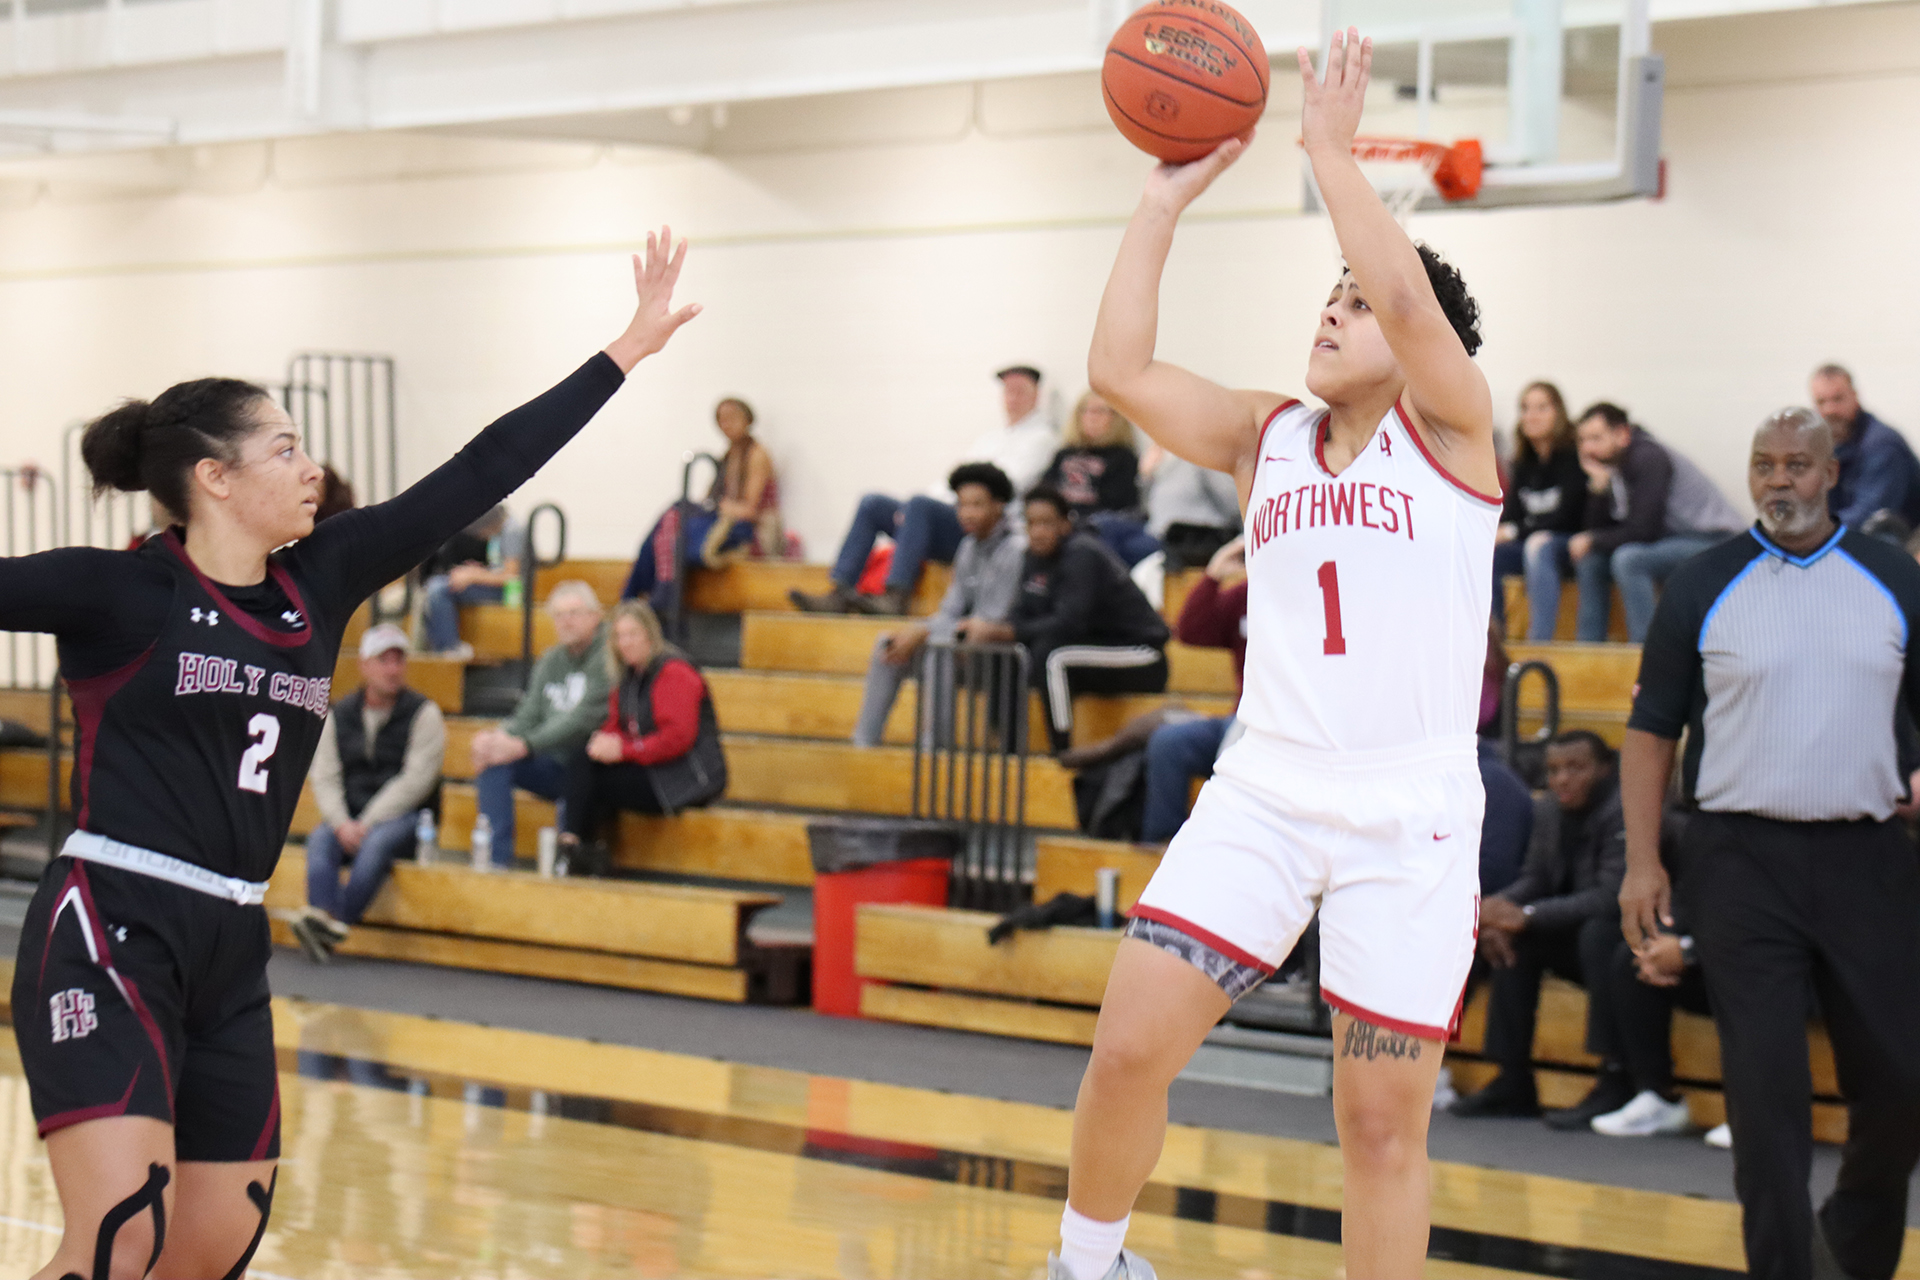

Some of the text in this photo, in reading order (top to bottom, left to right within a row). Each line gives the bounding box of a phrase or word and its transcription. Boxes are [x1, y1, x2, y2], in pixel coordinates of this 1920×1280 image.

[1143, 22, 1238, 70] LEGACY
[1251, 482, 1415, 558] NORTHWEST
[1317, 560, 1346, 656] 1
[175, 651, 265, 696] HOLY
[238, 712, 280, 794] 2
